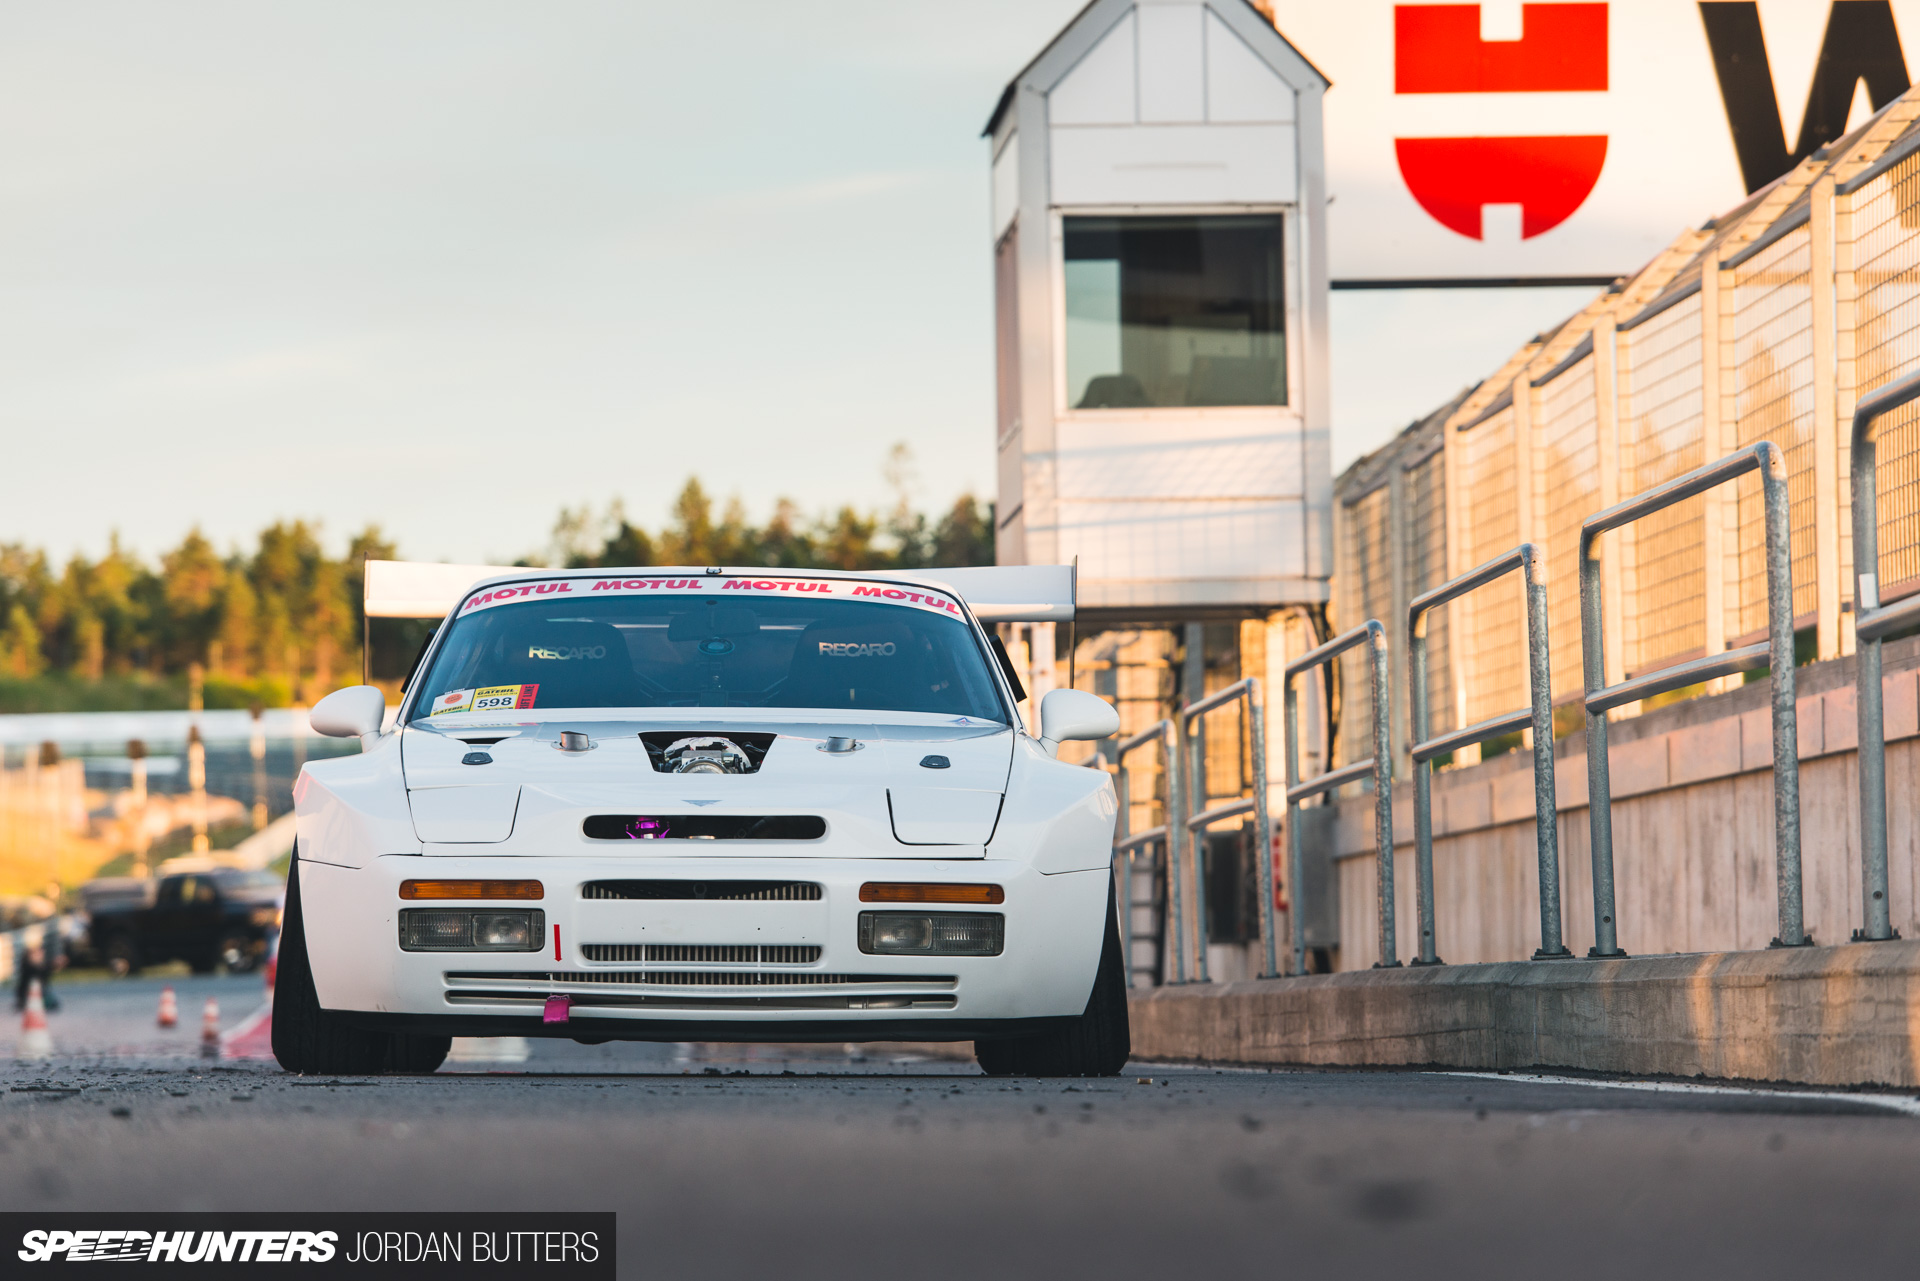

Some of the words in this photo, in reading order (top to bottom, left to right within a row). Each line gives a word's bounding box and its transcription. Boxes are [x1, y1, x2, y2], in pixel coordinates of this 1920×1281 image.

[464, 583, 573, 611] MOTUL
[591, 579, 703, 591] MOTUL
[721, 580, 833, 593] MOTUL
[852, 586, 961, 615] MOTUL
[528, 645, 606, 660] RECARO
[818, 641, 897, 657] RECARO
[477, 697, 512, 708] 598
